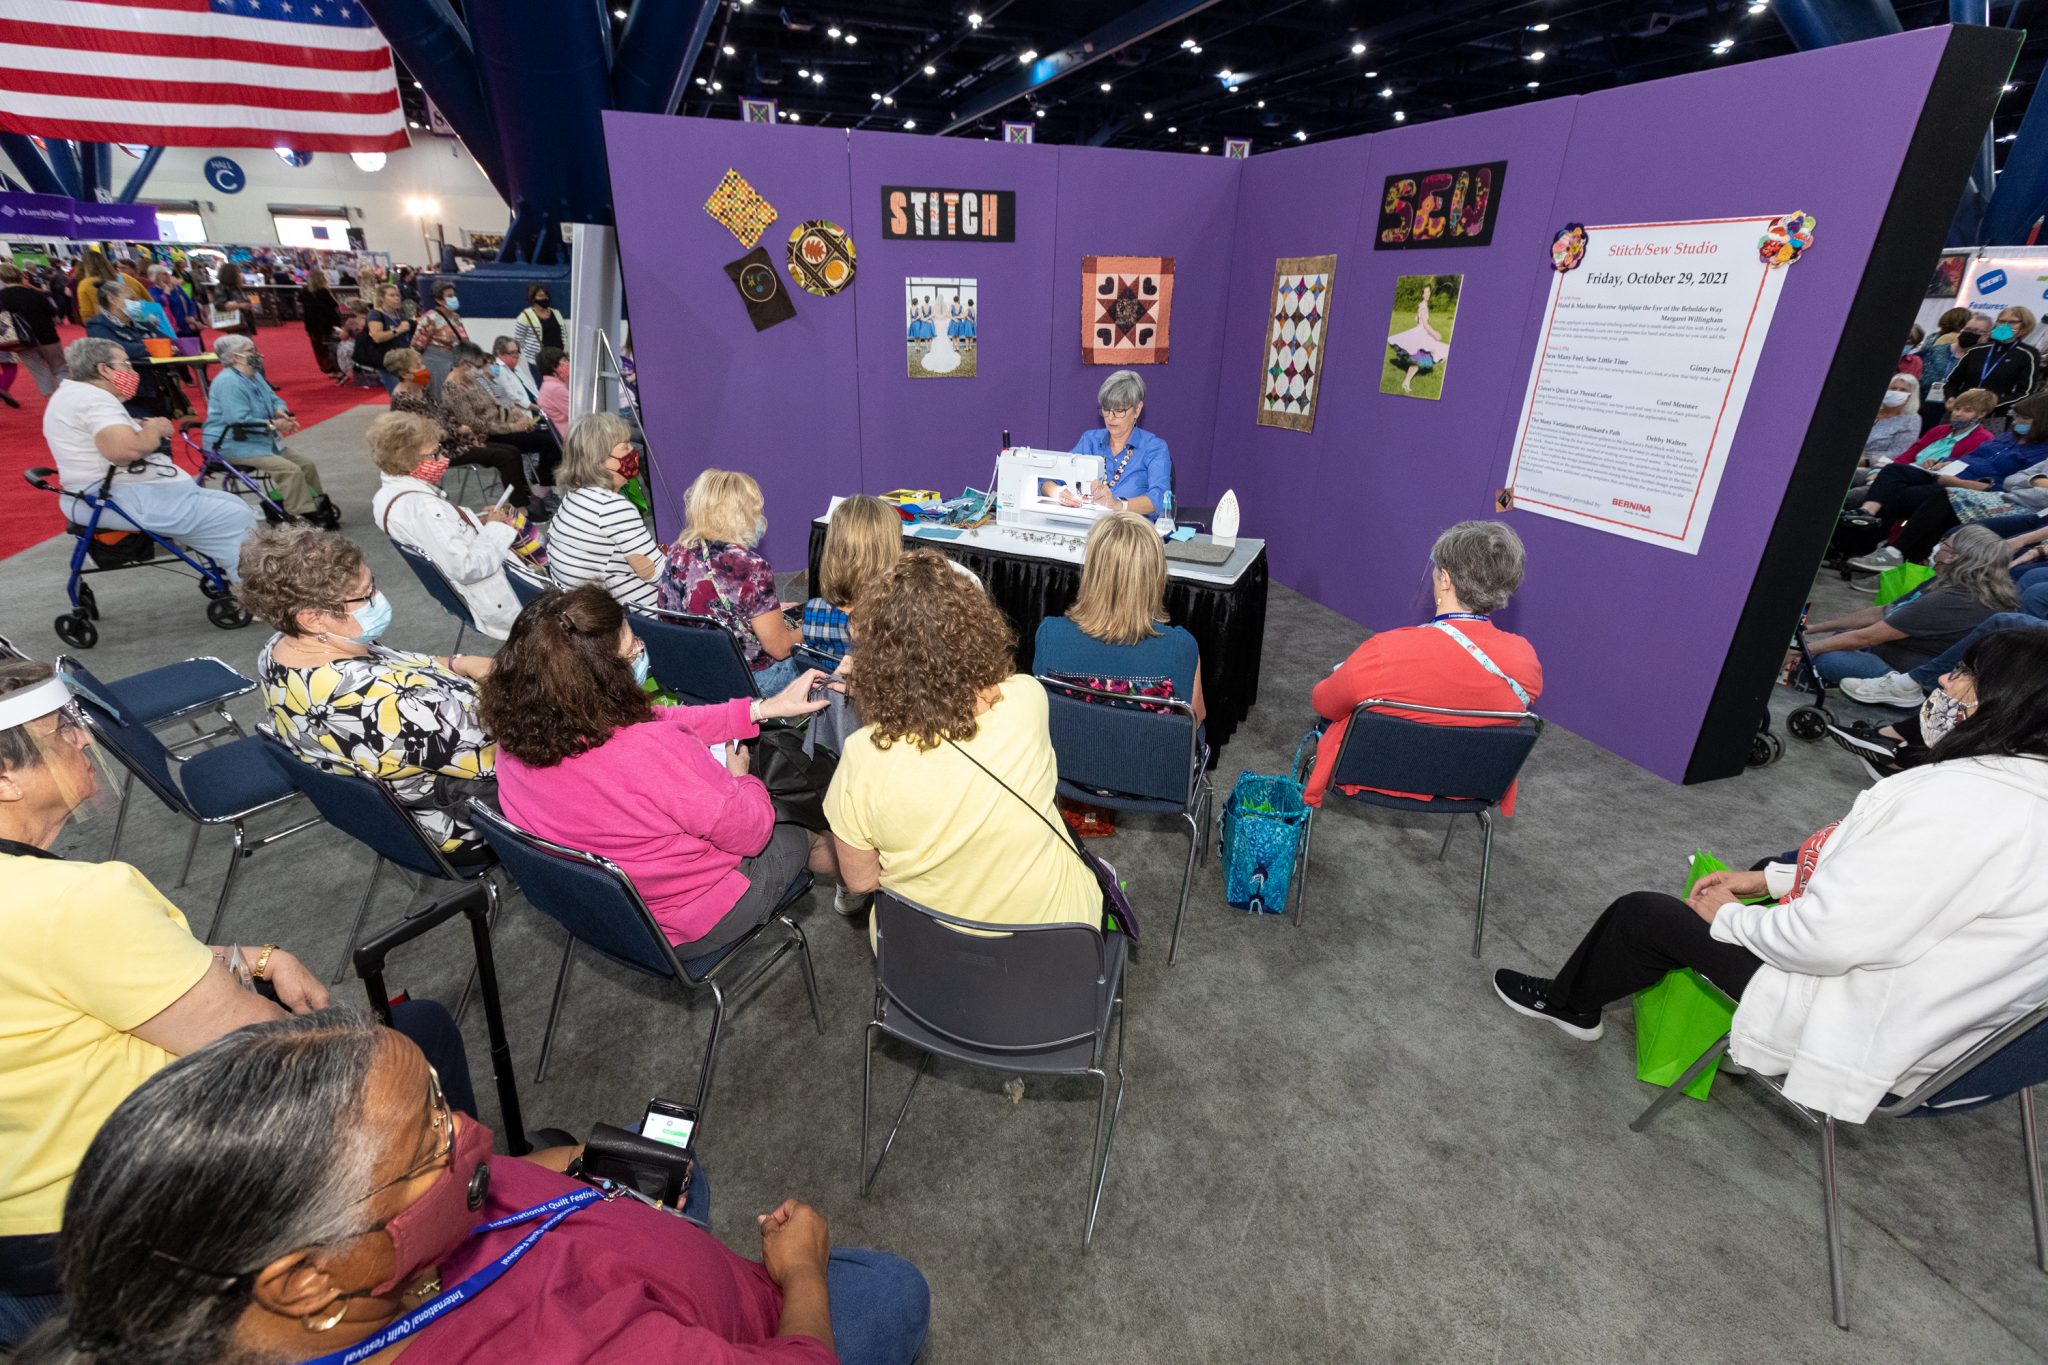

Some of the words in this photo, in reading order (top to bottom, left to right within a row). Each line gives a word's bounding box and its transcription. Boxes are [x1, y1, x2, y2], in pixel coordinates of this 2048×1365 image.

[210, 160, 233, 170] HALL
[216, 170, 238, 190] C
[890, 192, 997, 236] STITCH
[1382, 168, 1491, 242] SEW
[1608, 243, 1671, 256] Stitch/Sew
[1673, 240, 1719, 254] Studio
[1586, 272, 1624, 287] Friday,
[1626, 272, 1676, 283] October
[1677, 272, 1695, 285] 29,
[1699, 272, 1729, 283] 2021
[1687, 315, 1723, 323] Willingham
[1557, 353, 1570, 361] Many
[1689, 364, 1710, 373] Ginny
[1712, 366, 1731, 374] Jones
[1646, 435, 1664, 443] Debby
[1666, 438, 1687, 446] Walters
[1612, 498, 1652, 513] BERNINA
[488, 1205, 547, 1228] International
[548, 1198, 570, 1210] Quilt
[570, 1189, 597, 1203] Festiva
[501, 1242, 529, 1265] Festival
[412, 1290, 464, 1329] International
[387, 1321, 411, 1342] Quilt
[343, 1335, 386, 1365] Festival
